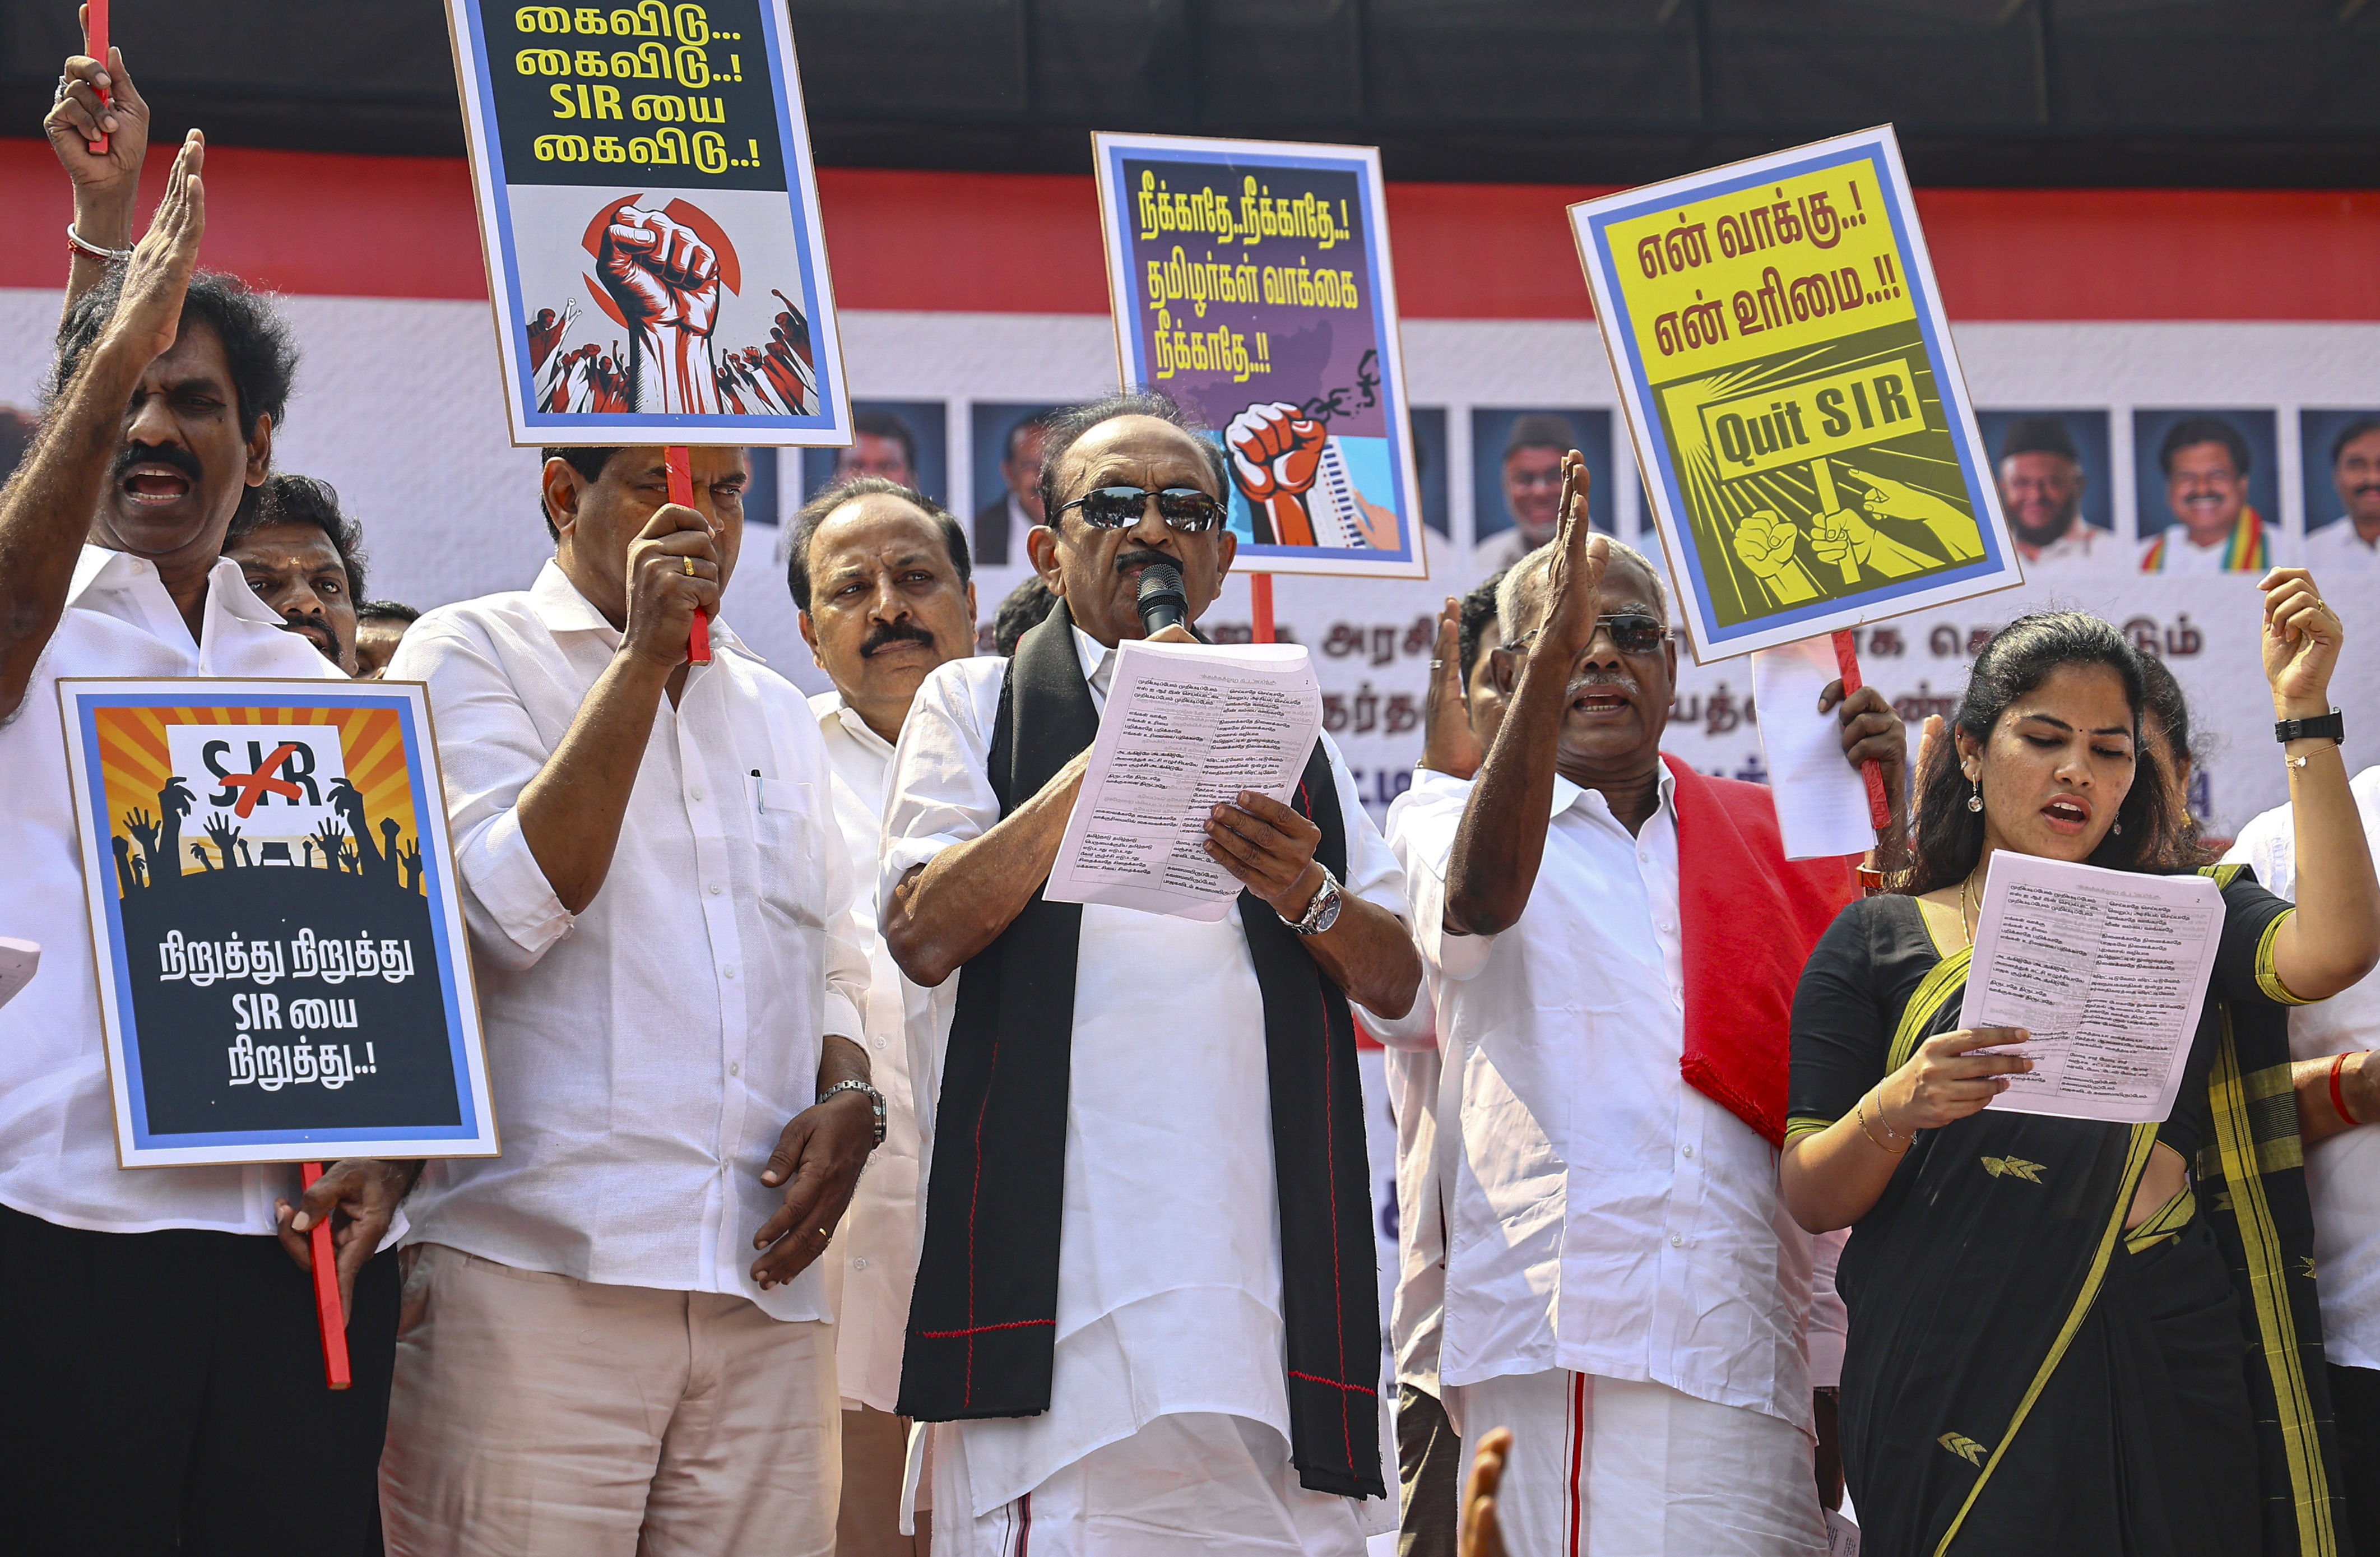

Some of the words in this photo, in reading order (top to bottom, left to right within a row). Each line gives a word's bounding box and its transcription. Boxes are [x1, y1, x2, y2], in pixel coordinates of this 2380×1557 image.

[516, 43, 742, 88] கைவிடு..!
[550, 84, 623, 119] SIR
[632, 95, 725, 123] யை
[534, 128, 760, 173] கைவிடு..!
[1639, 214, 1711, 279] என்
[1718, 182, 1865, 258] வாக்கு..!
[1148, 246, 1259, 317] தமிழர்கள்
[1264, 257, 1357, 308] வாக்கை
[1655, 292, 1728, 355] என்
[1716, 401, 1810, 466] Quit
[1816, 375, 1912, 437] SIR
[203, 740, 321, 807] SIR
[159, 930, 285, 986] நிறுத்து
[291, 928, 414, 984] நிறுத்து
[233, 994, 282, 1030] SIR
[290, 999, 358, 1029] யை
[228, 1034, 376, 1091] நிறுத்து..!
